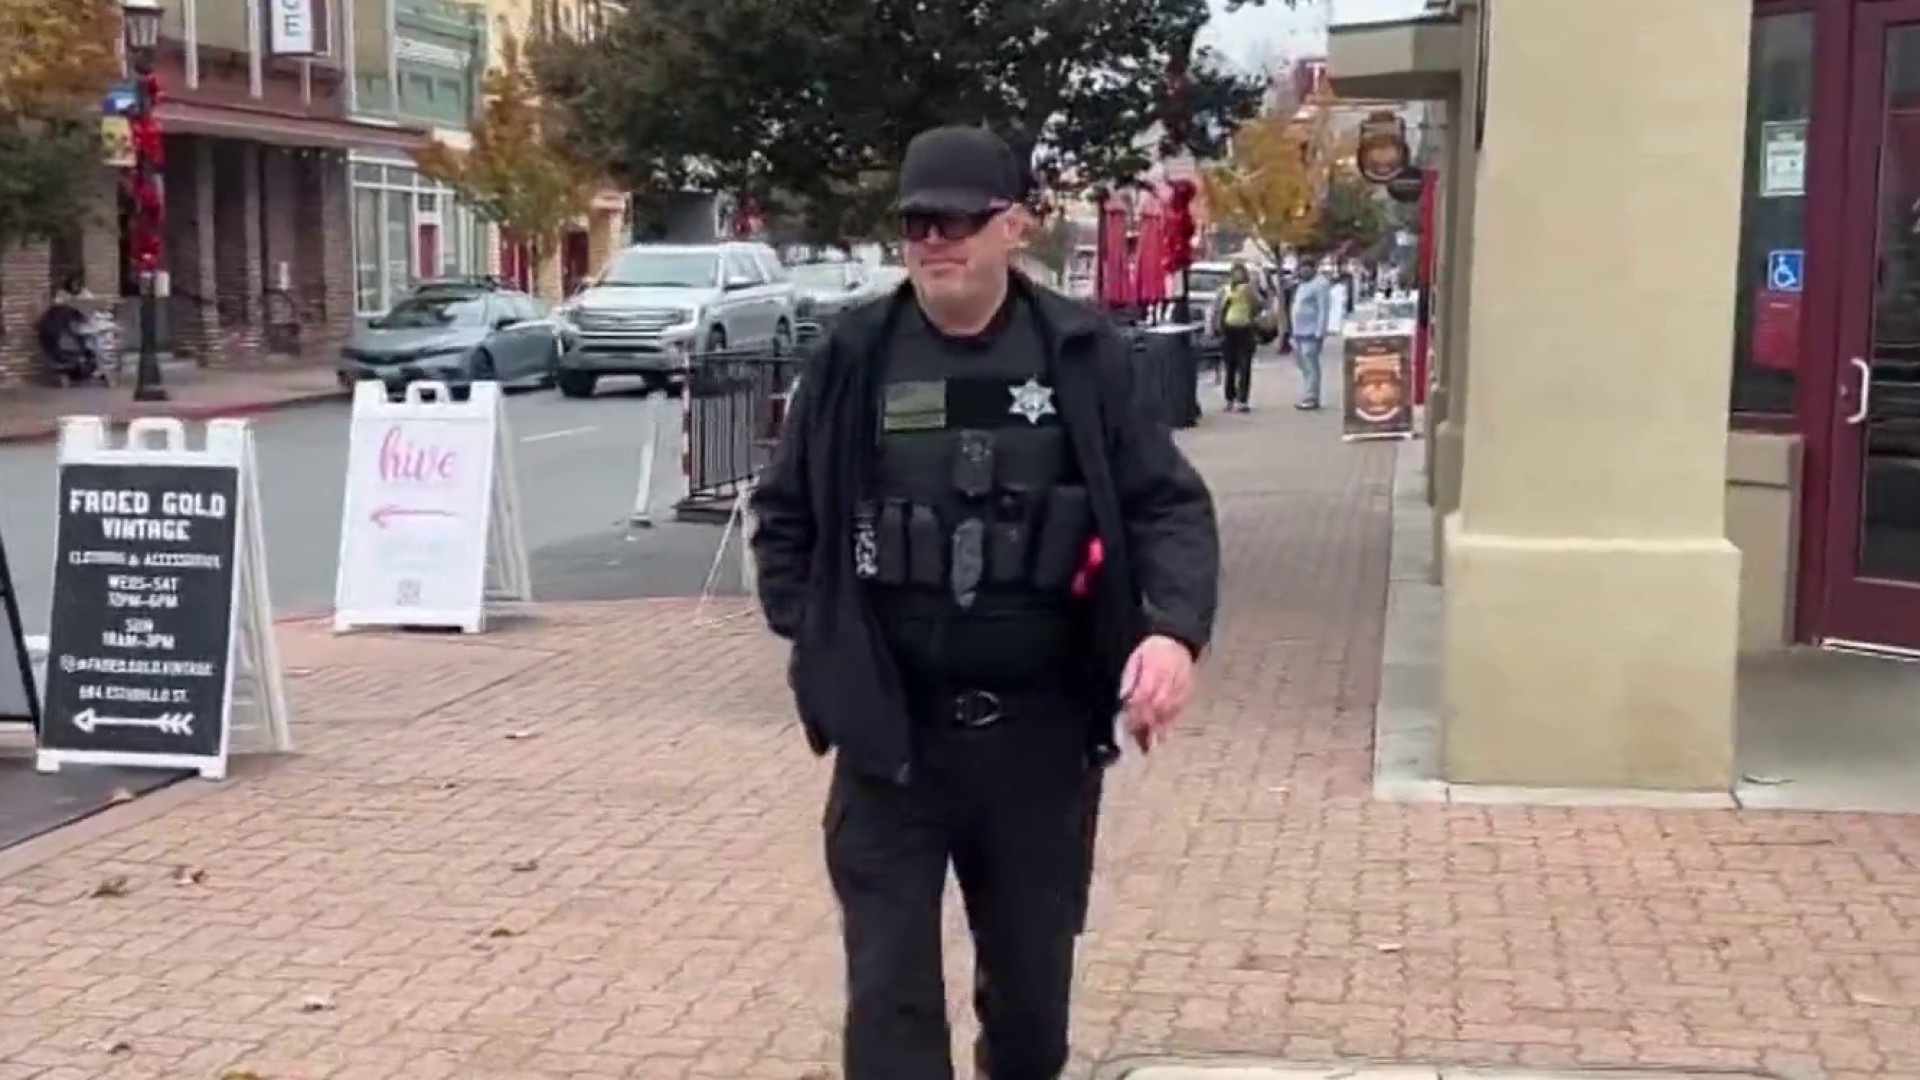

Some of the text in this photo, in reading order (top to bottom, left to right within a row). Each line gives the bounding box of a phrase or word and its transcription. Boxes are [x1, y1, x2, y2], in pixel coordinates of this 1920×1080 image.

[379, 425, 457, 481] hive
[69, 489, 226, 518] FADED GOLD
[102, 518, 192, 541] VINTAGE
